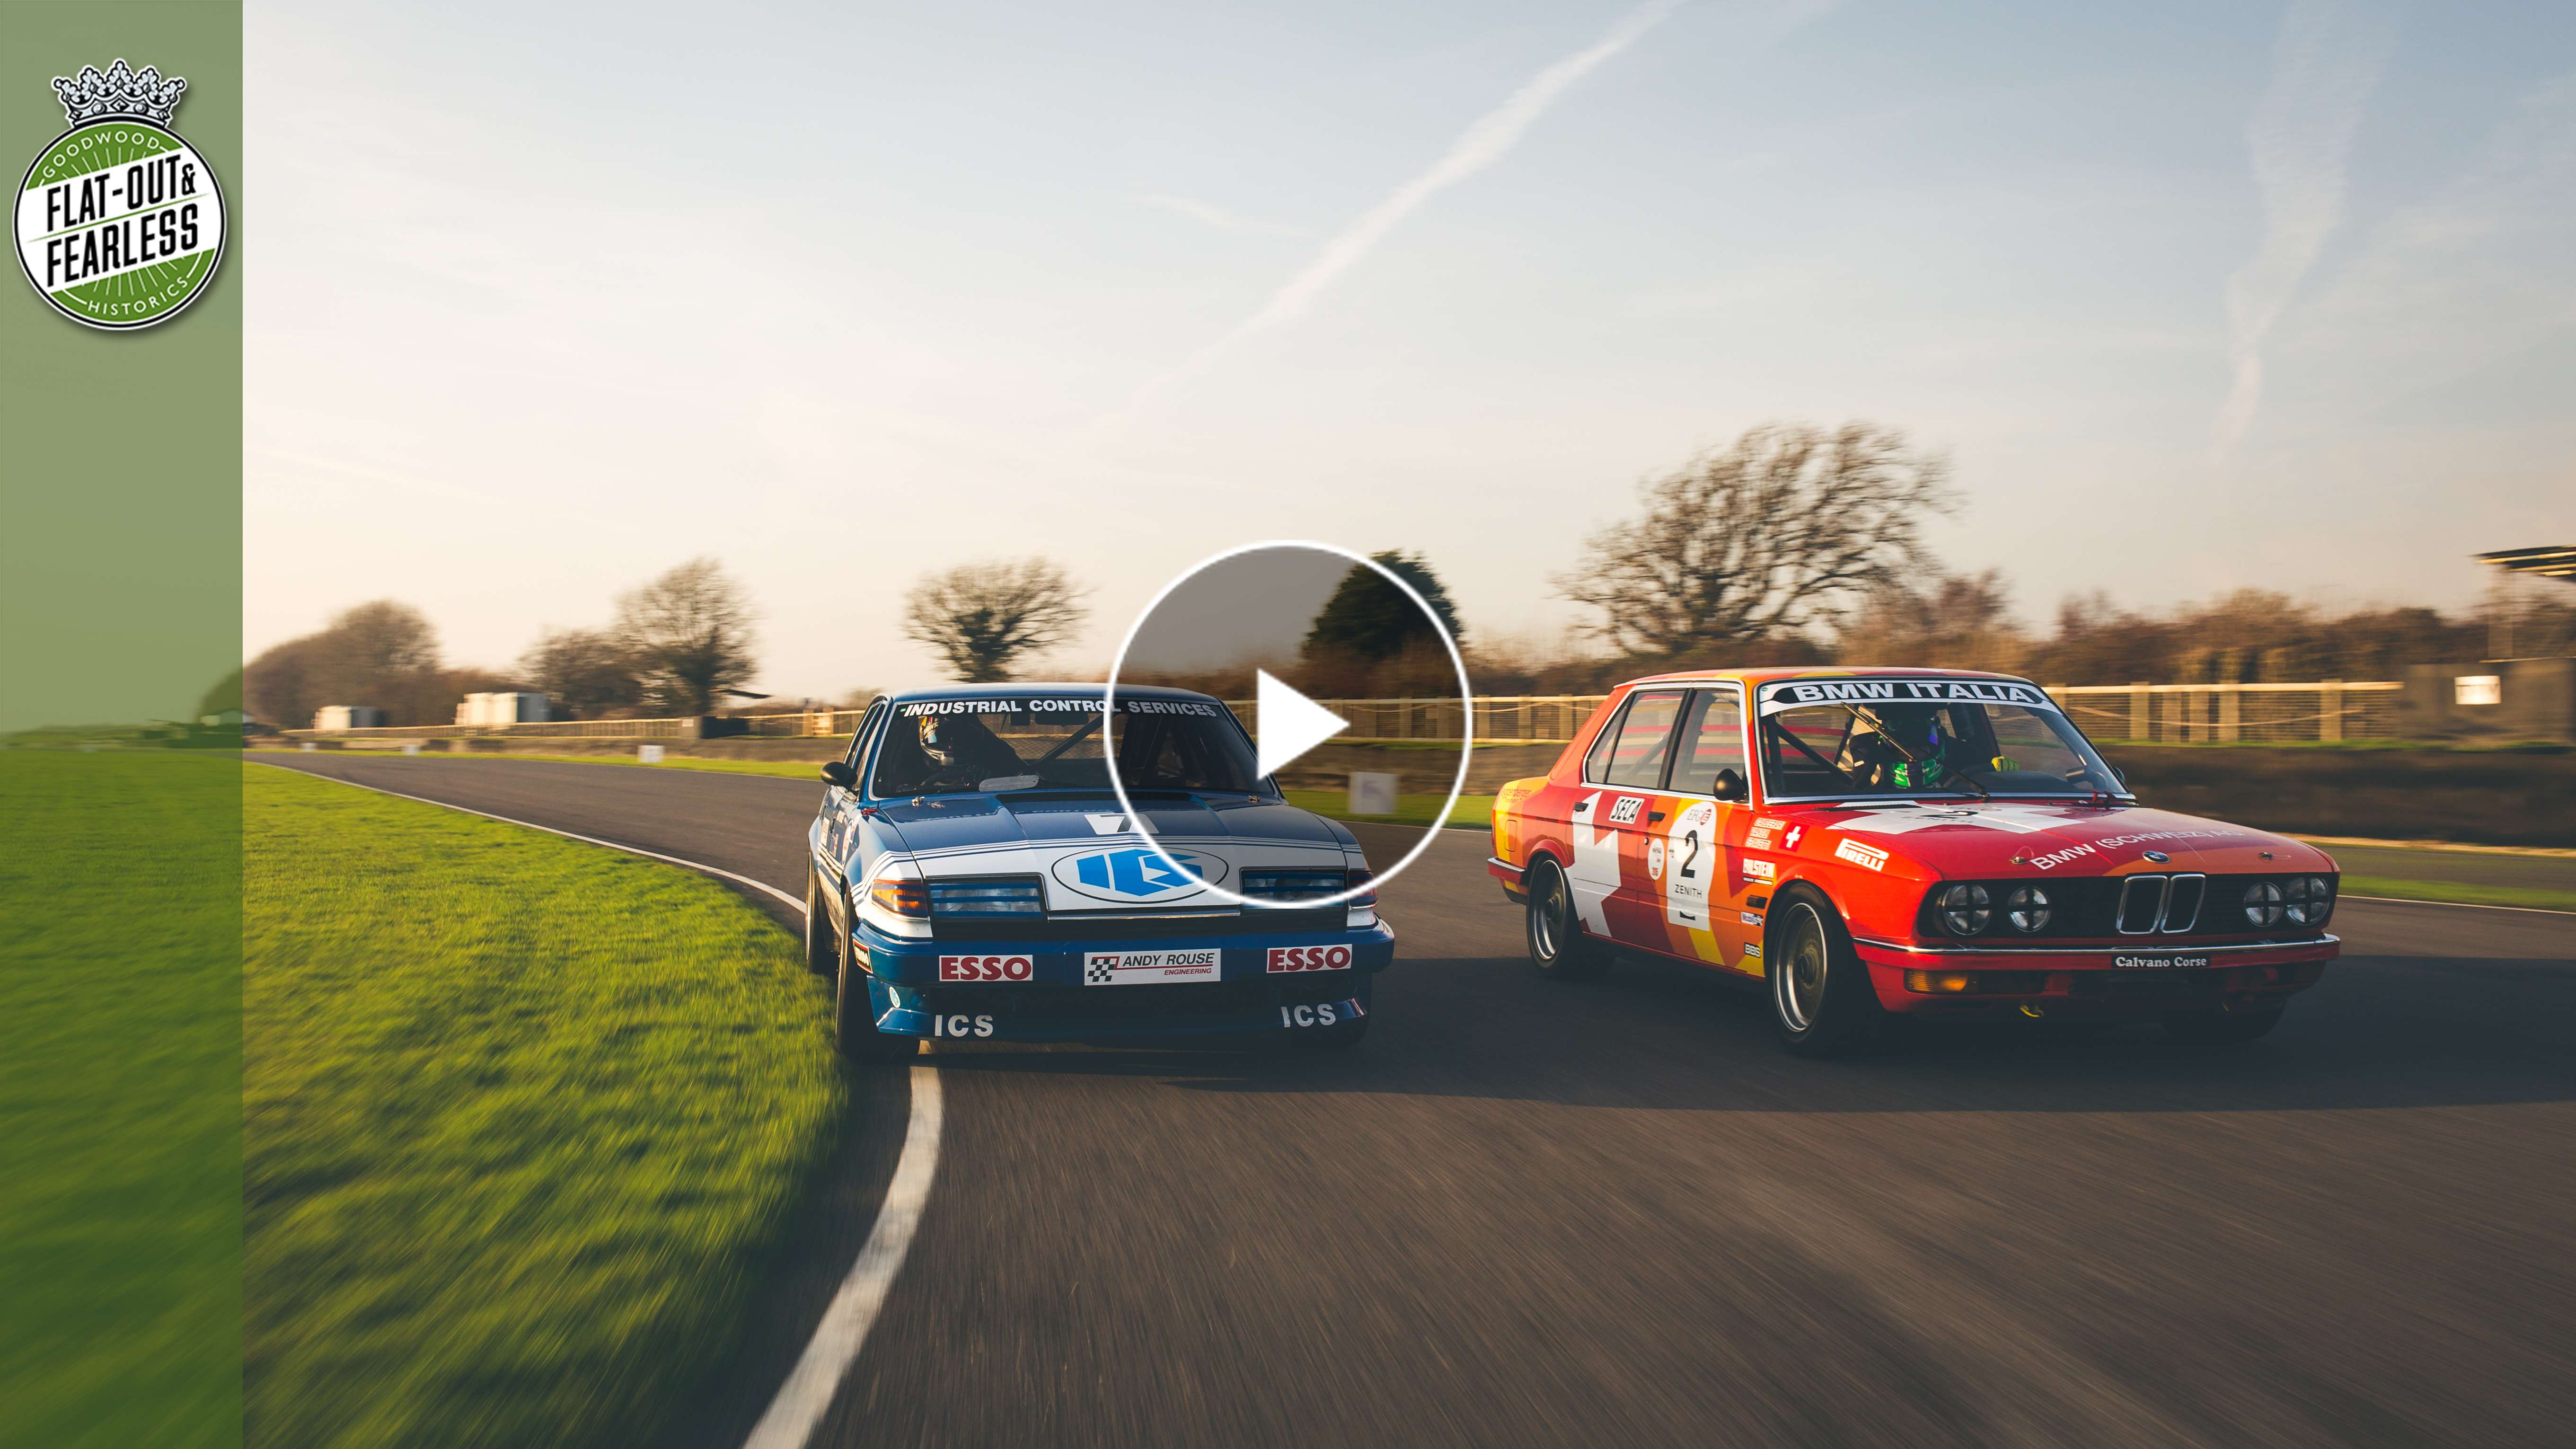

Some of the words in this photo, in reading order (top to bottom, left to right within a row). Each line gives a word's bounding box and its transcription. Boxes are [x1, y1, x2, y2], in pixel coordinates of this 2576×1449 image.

[1793, 683, 1893, 701] BMW
[1906, 683, 2035, 704] ITALIA
[903, 700, 1022, 717] INDUSTRIAL
[1029, 699, 1121, 712] CONTROL
[1128, 701, 1217, 717] SERVICES
[1611, 799, 1642, 822] SECA
[1100, 814, 1135, 833] 7
[1681, 830, 1698, 879] 2
[1835, 838, 1889, 872] PIRELLI
[2029, 844, 2097, 870] BMW
[2095, 831, 2214, 849] (SCHWEIZ)
[1743, 858, 1775, 878] BILSTEIN
[1675, 884, 1703, 899] ZENITH
[1123, 954, 1161, 967] ANDY
[1166, 953, 1215, 965] ROUSE
[1268, 946, 1351, 972] ESSO
[1745, 944, 1761, 958] BBS
[941, 956, 1032, 981] ESSO
[2115, 956, 2170, 968] Calvano
[2174, 956, 2207, 967] Corse
[935, 1015, 993, 1037] ICS
[1280, 1004, 1336, 1028] ICS
